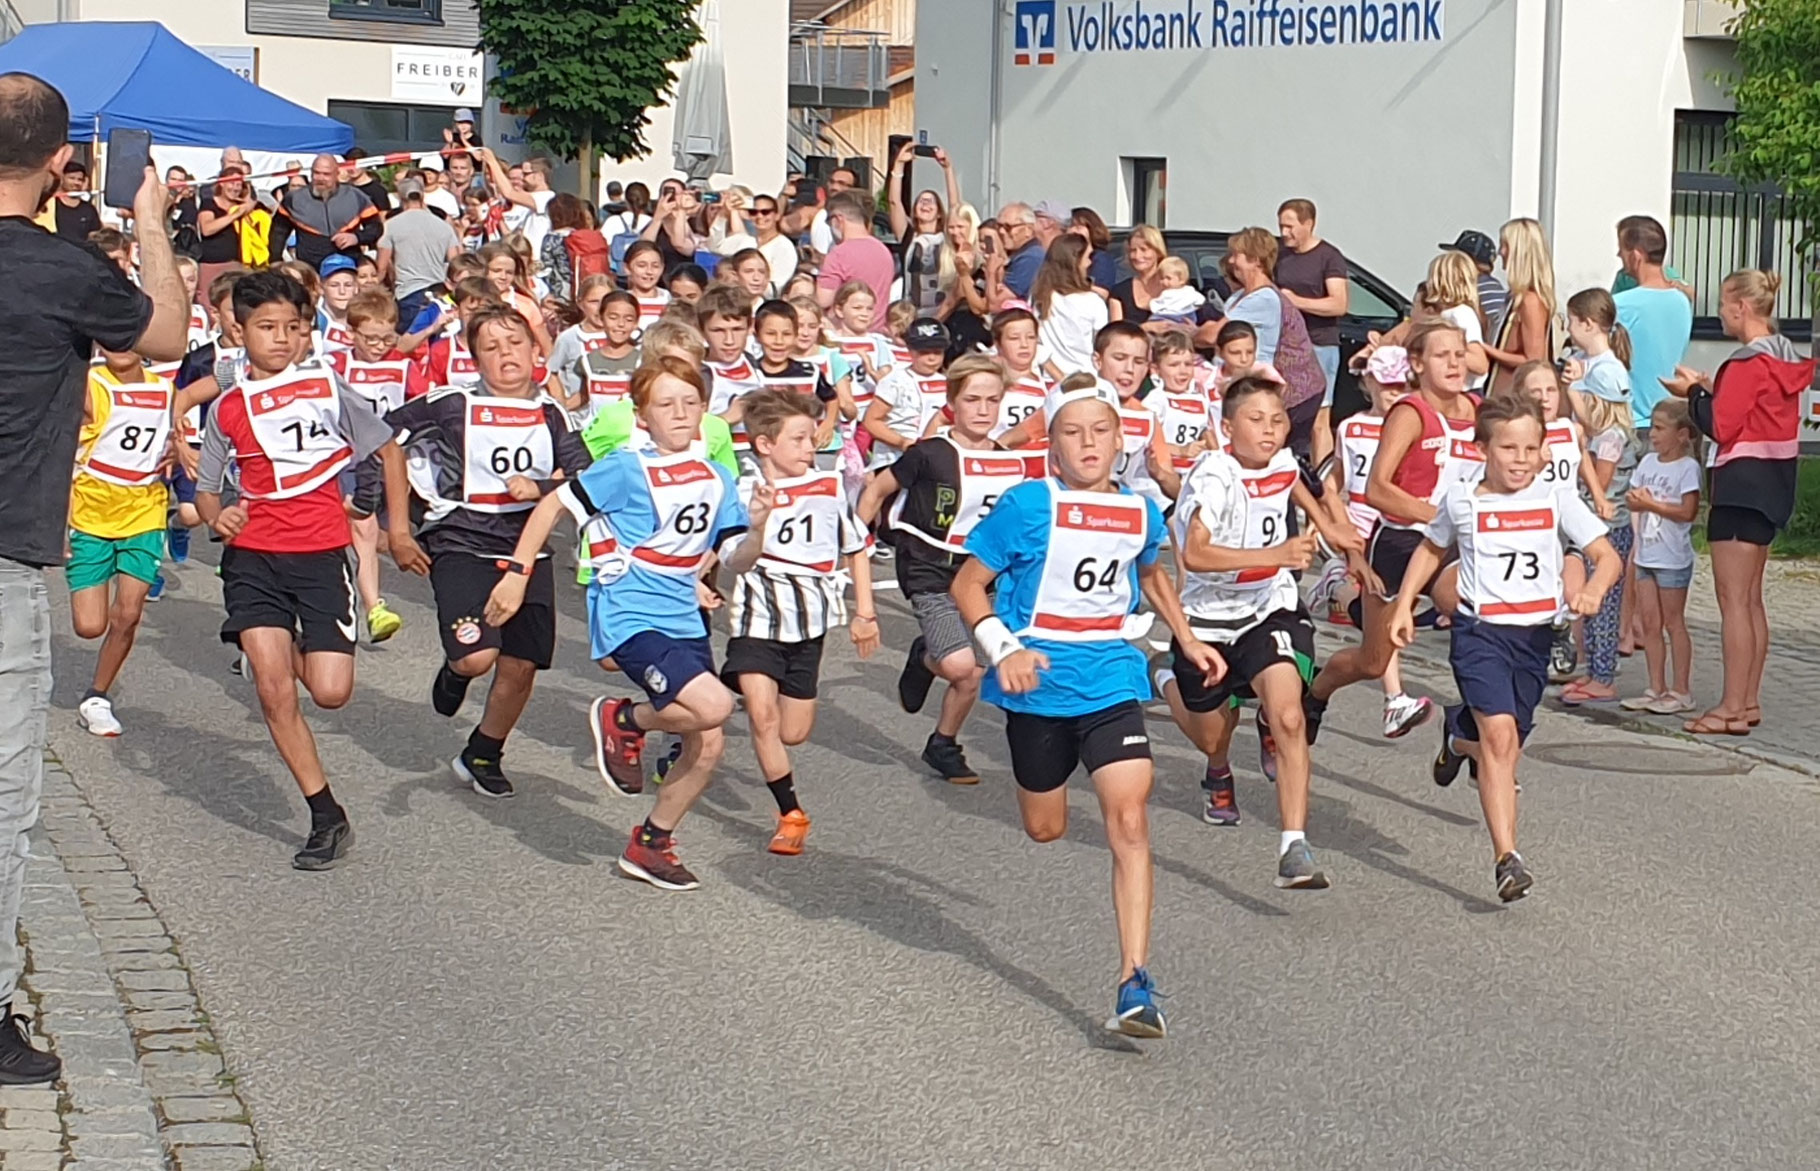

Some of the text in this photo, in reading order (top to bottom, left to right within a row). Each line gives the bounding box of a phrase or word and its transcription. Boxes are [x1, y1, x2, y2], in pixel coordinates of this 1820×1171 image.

[1068, 0, 1441, 51] Volksbank Raiffeisenbank
[397, 62, 478, 78] FREIBER
[1007, 405, 1036, 427] 58
[120, 426, 157, 453] 87
[281, 420, 330, 453] 74
[1175, 424, 1199, 444] 83
[491, 446, 533, 474] 60
[1355, 454, 1367, 477] 2
[1543, 459, 1570, 482] 30
[674, 502, 711, 535] 63
[977, 494, 998, 518] 5
[777, 514, 813, 544] 61
[1074, 557, 1119, 593] 64
[1498, 551, 1540, 581] 73
